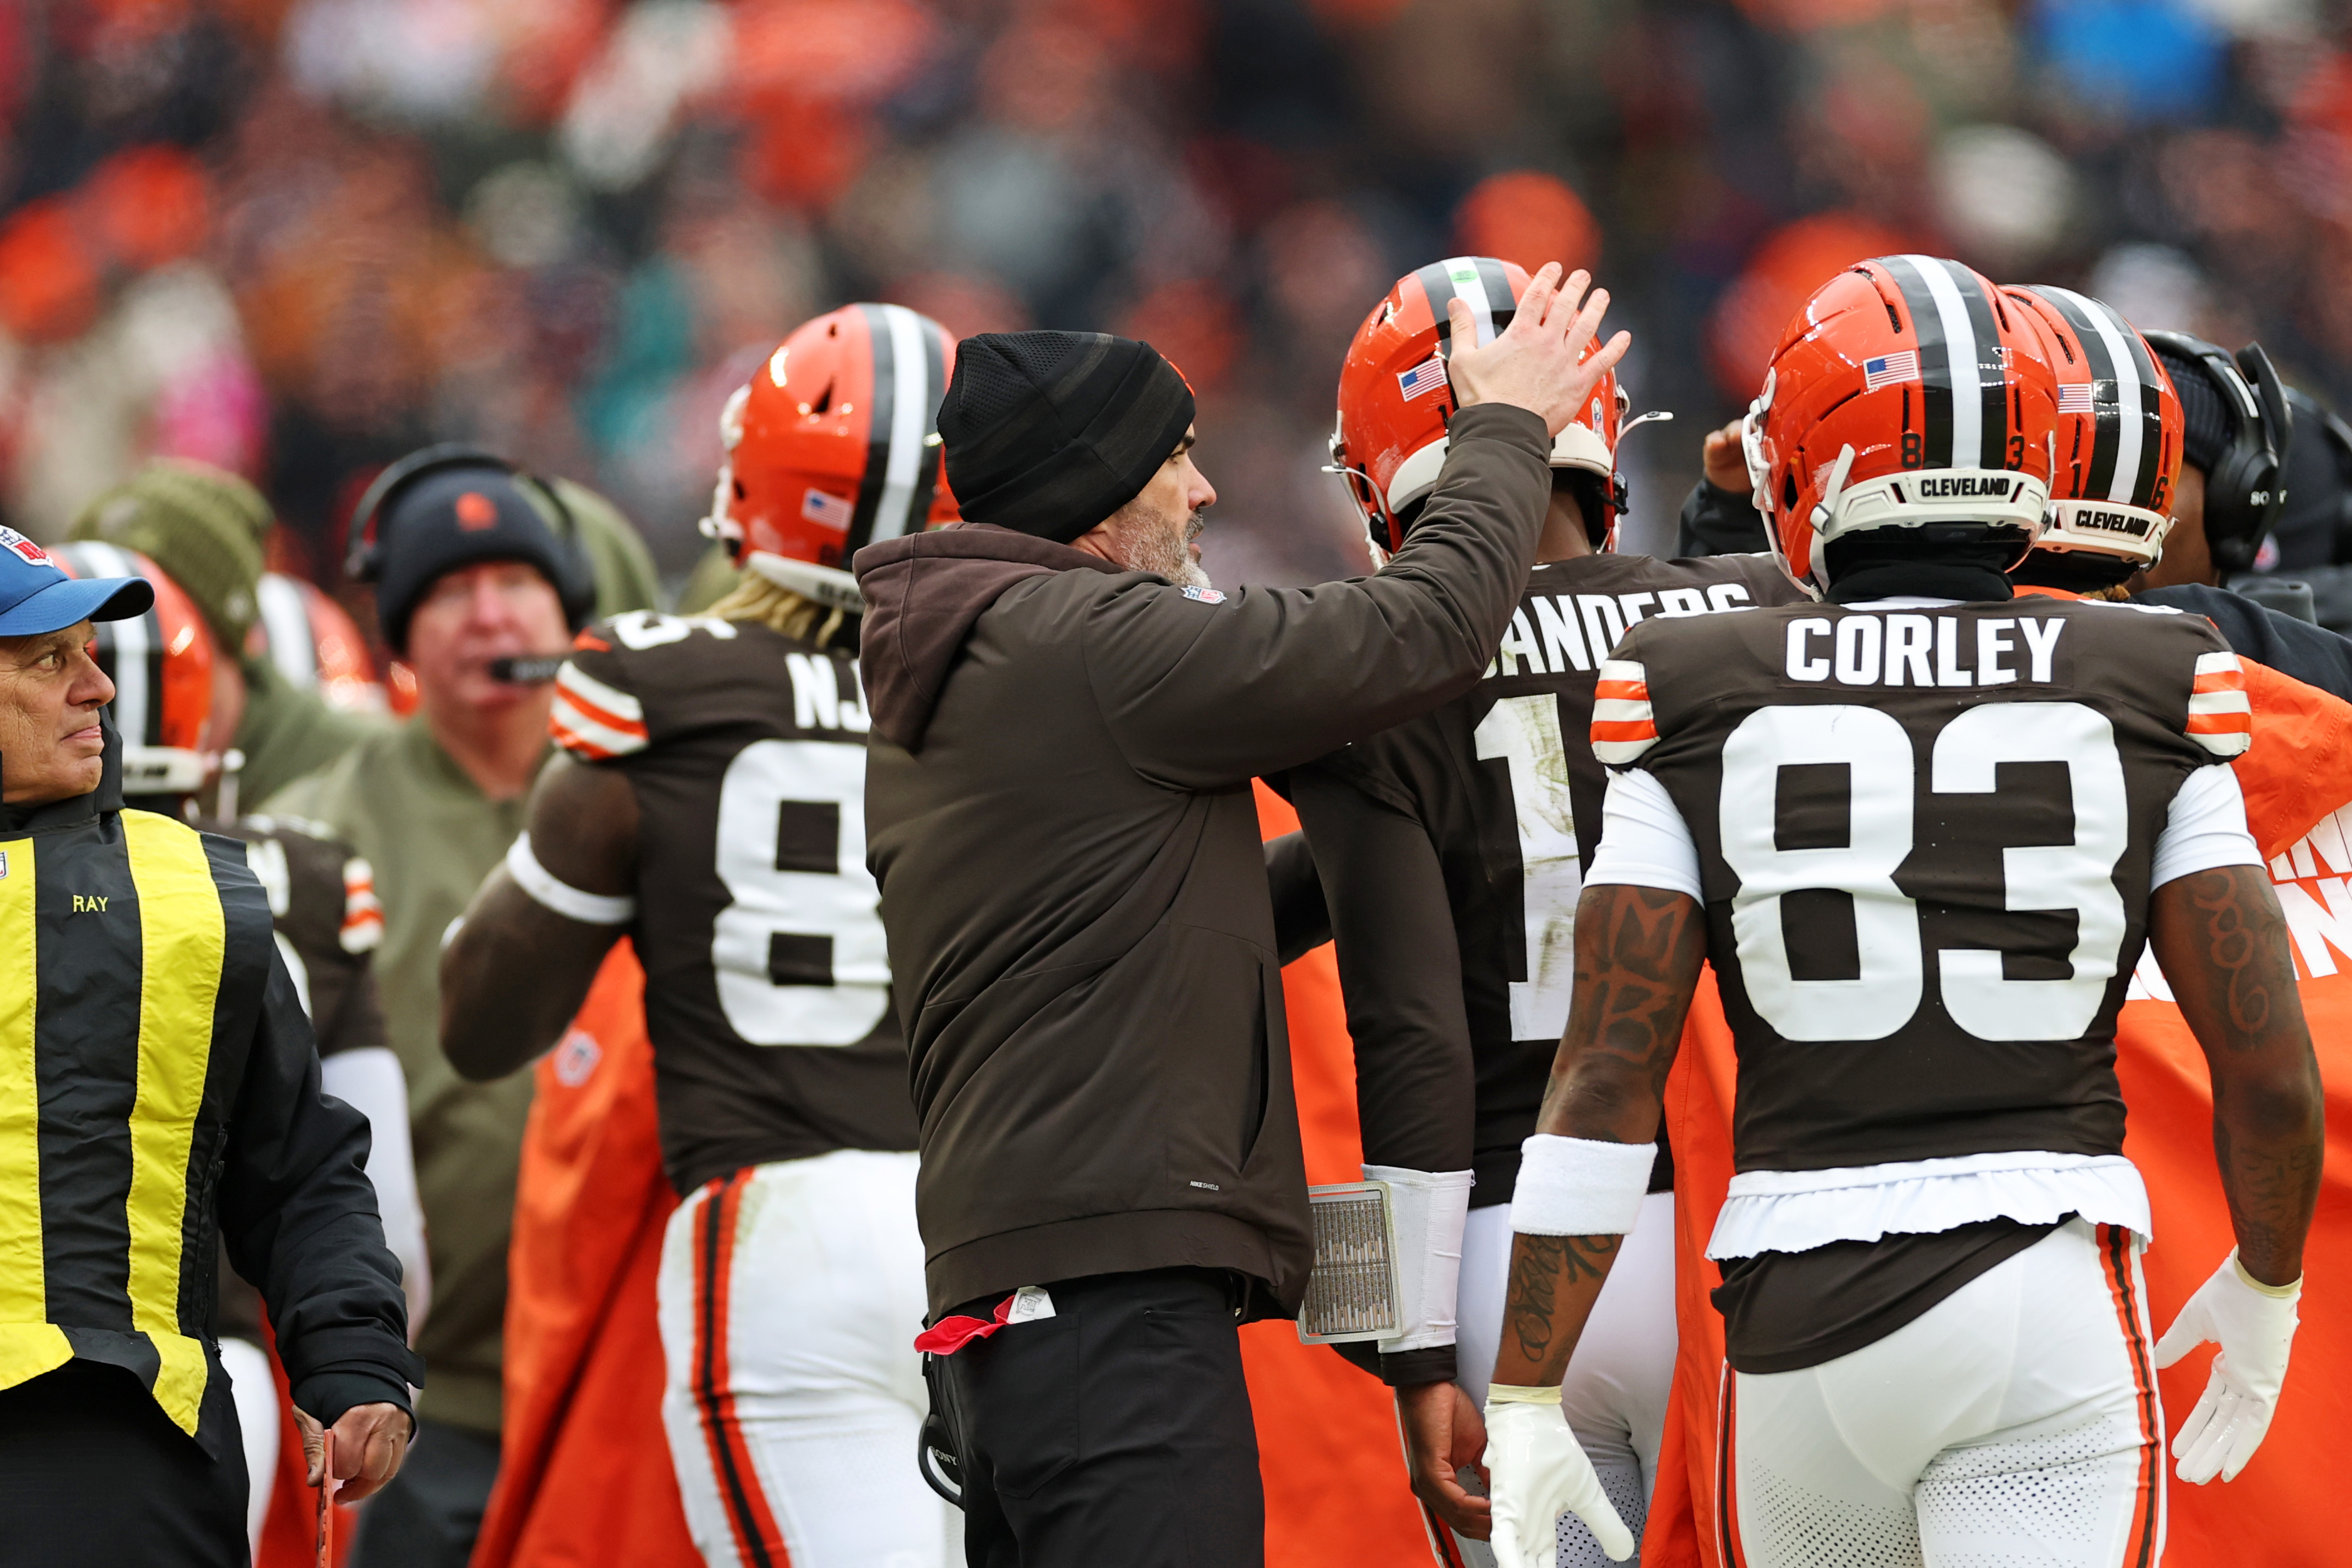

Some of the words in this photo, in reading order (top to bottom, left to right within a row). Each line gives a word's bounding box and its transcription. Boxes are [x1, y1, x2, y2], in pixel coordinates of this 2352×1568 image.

[1902, 433, 1921, 469] 8
[2007, 435, 2024, 471] 3
[1921, 478, 2010, 496] CLEVELAND
[2069, 463, 2081, 498] 1
[2149, 476, 2169, 510] 6
[2250, 490, 2287, 506] SOY
[2076, 509, 2150, 536] CLEVELAND
[1481, 583, 1750, 679] ANDE
[1785, 614, 2066, 687] CORLEY
[1474, 693, 1582, 1042] 1
[1719, 701, 2128, 1042] 83
[73, 895, 109, 913] RAY
[711, 739, 893, 1047] 8
[929, 1446, 957, 1466] SONY
